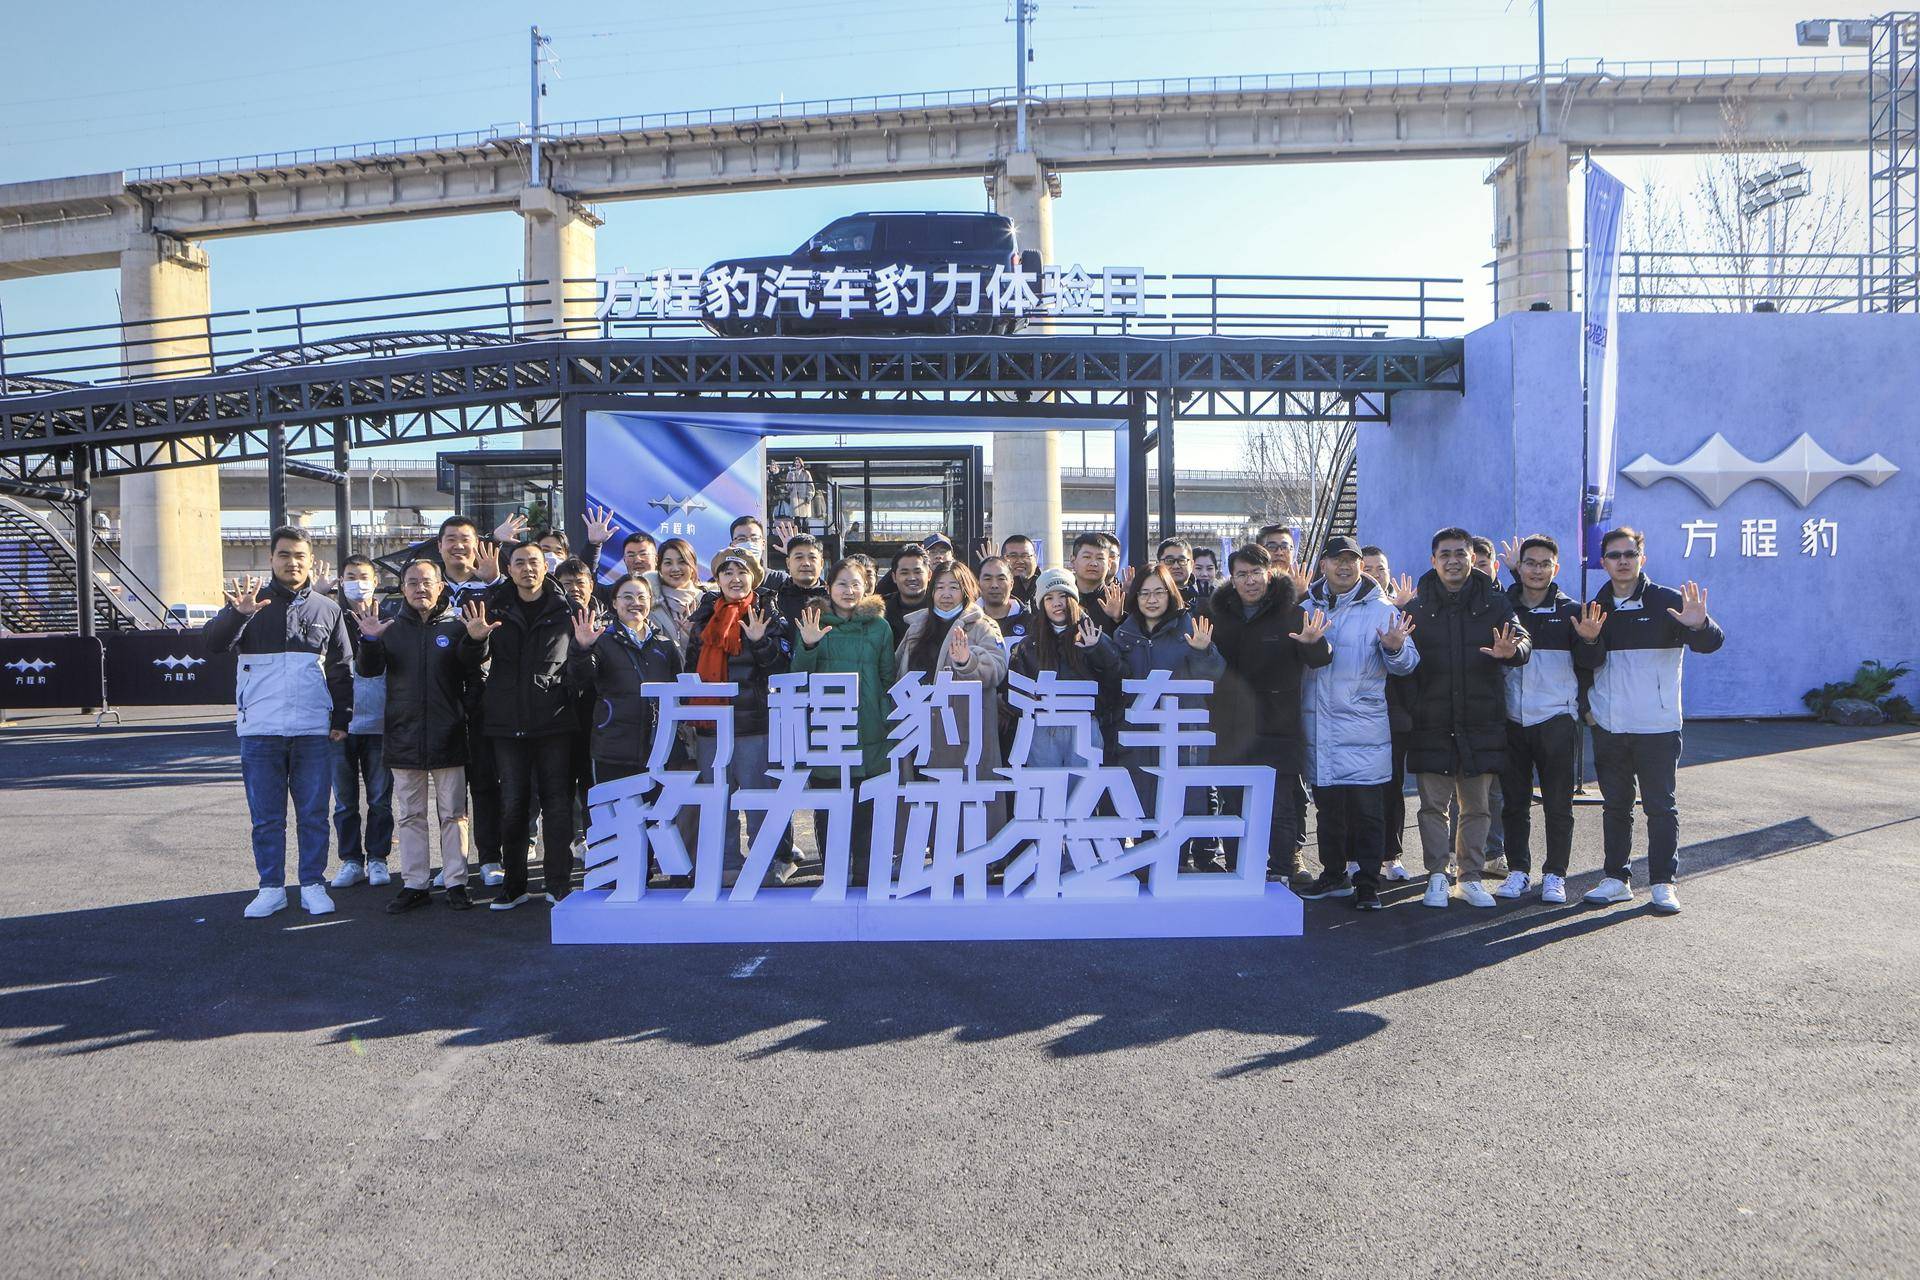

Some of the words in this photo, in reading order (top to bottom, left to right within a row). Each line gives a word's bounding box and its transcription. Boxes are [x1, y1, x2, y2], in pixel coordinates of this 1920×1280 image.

[594, 263, 1146, 321] 方程豹汽车豹力体验日
[660, 521, 697, 536] 方程豹
[1681, 518, 1839, 558] 方程豹
[15, 676, 46, 685] 方程豹
[164, 672, 196, 682] 方程豹
[640, 669, 1217, 770] 方程豹汽车
[583, 764, 1278, 901] 豹力体验日
